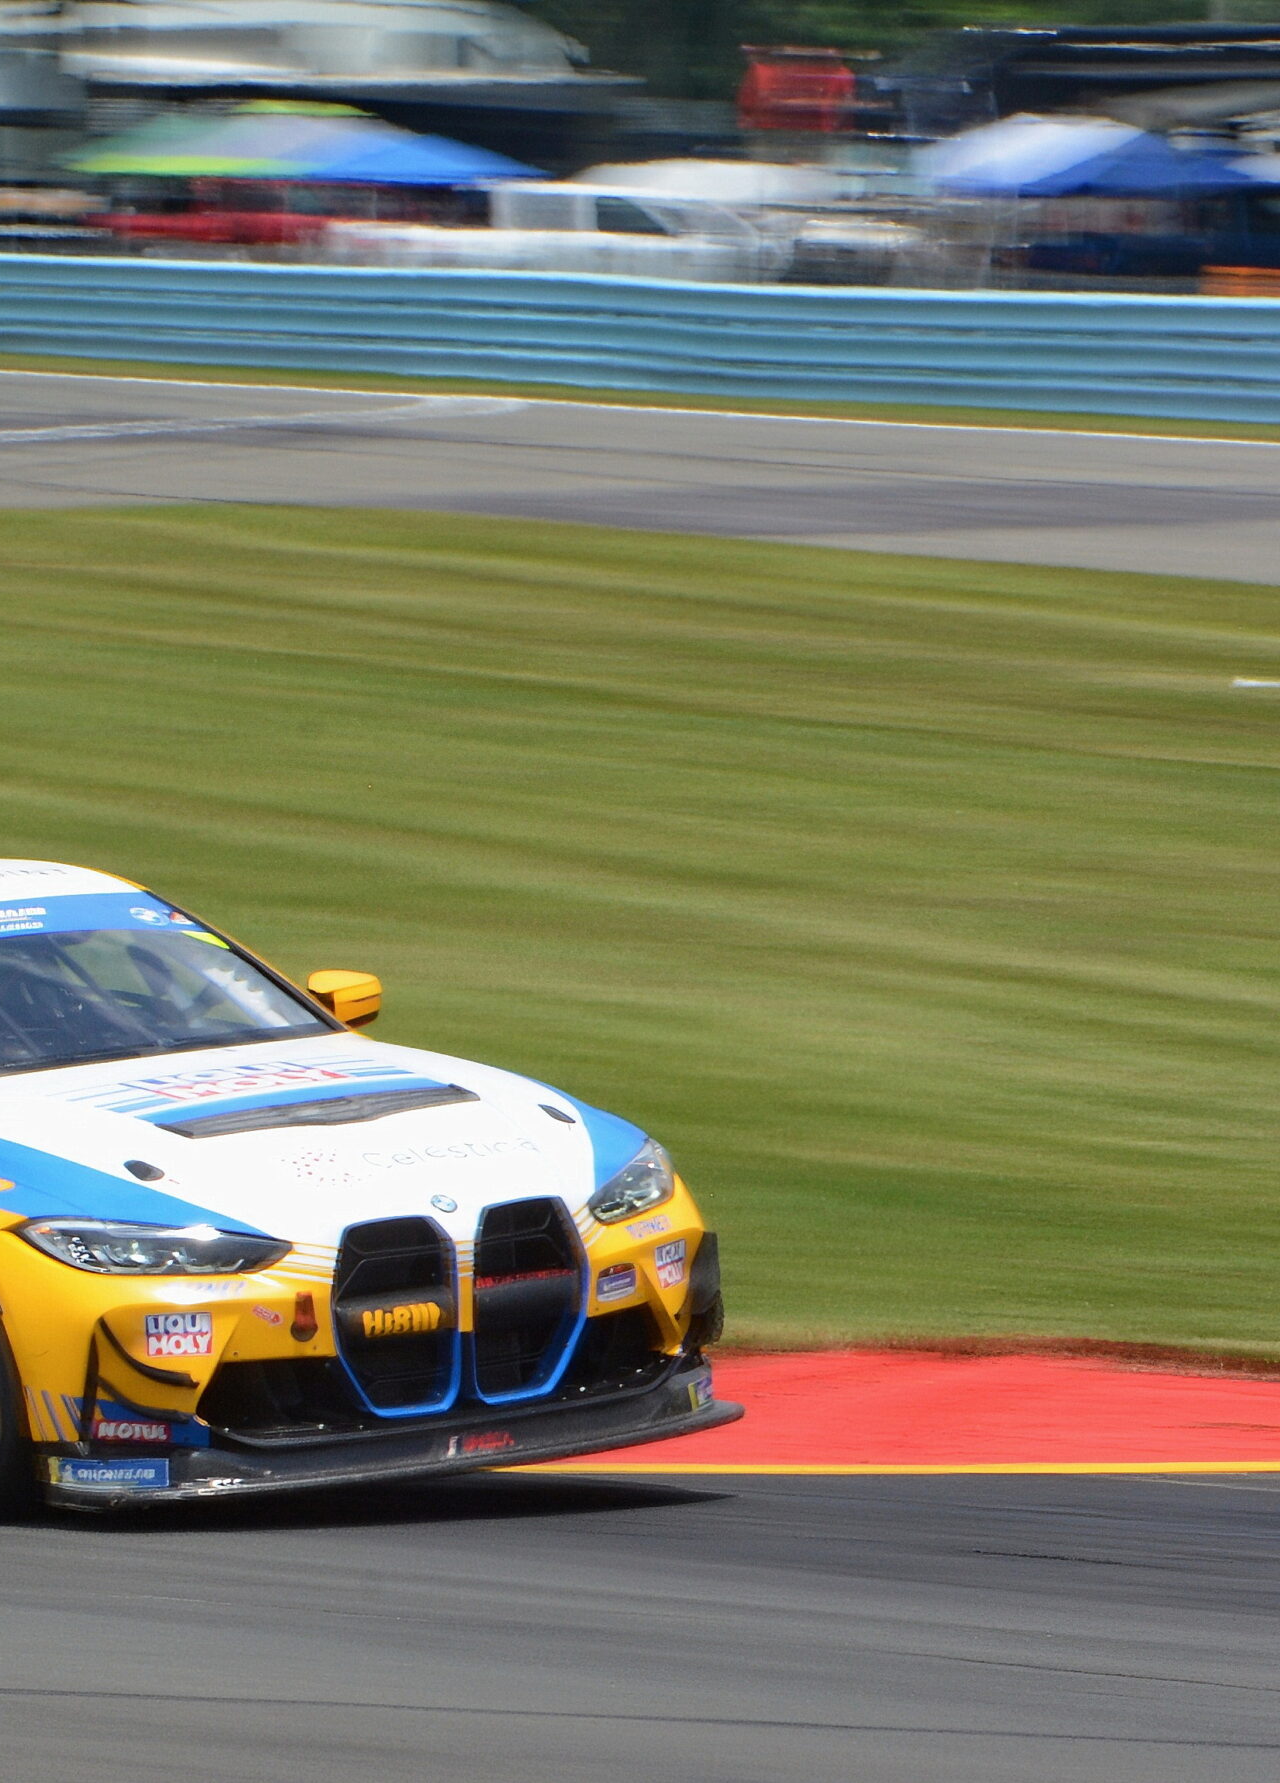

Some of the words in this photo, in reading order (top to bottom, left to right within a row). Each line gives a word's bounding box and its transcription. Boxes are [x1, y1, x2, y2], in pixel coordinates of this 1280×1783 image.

[146, 1313, 211, 1334] LIQUI
[147, 1333, 212, 1355] MOLY
[98, 1422, 168, 1441] MOTUL
